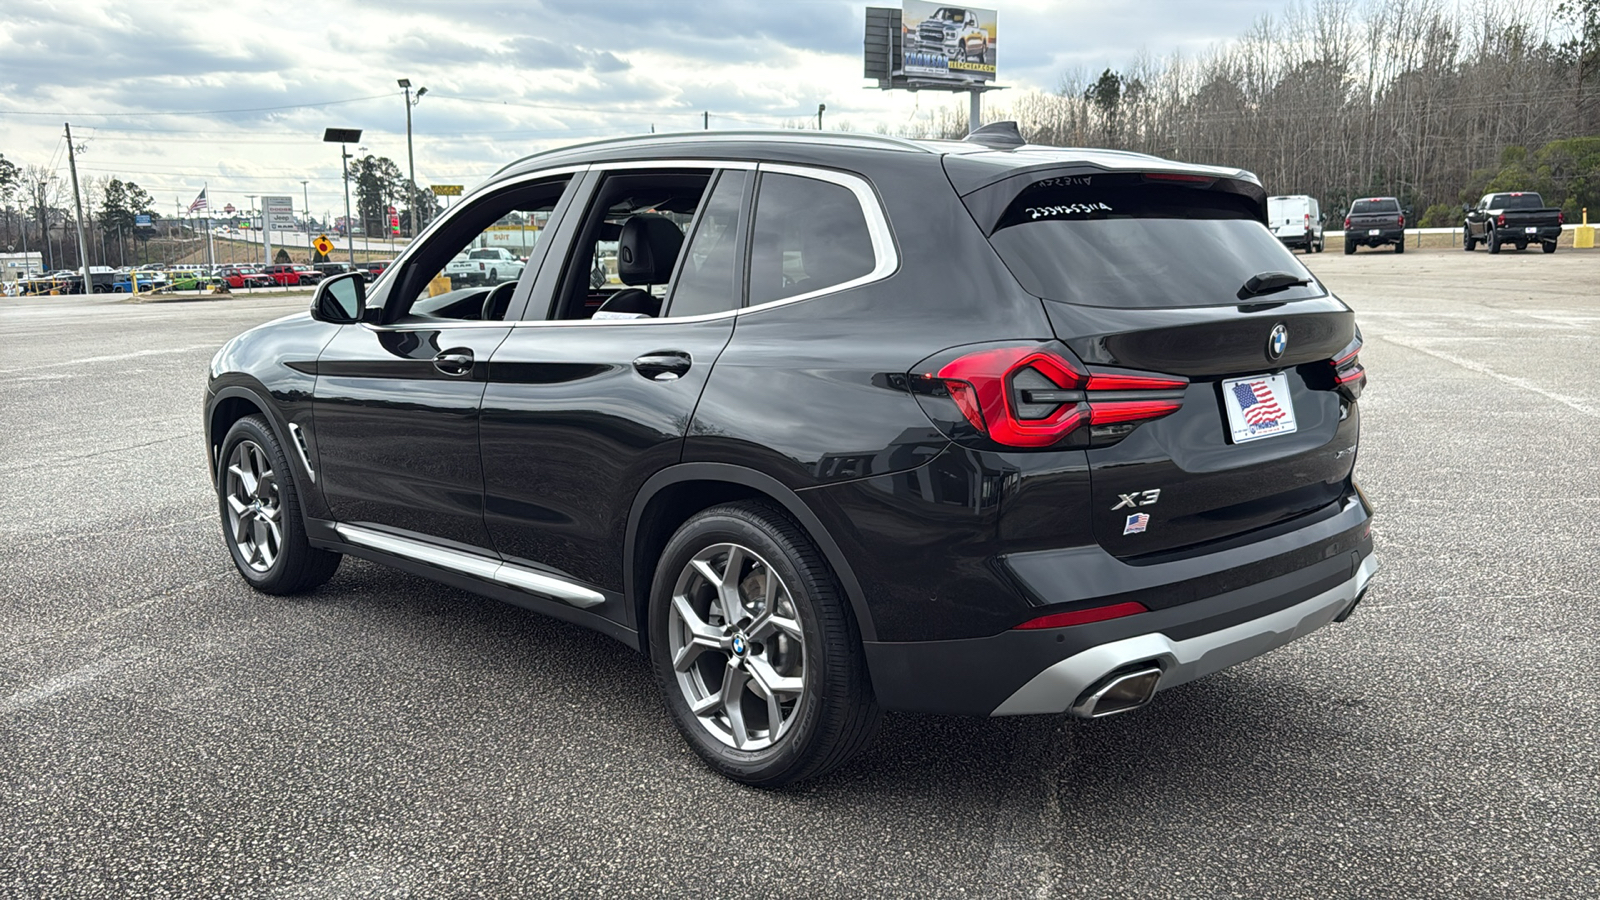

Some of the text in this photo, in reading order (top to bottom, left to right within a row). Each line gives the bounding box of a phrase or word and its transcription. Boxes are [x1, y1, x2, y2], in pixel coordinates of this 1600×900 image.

[904, 52, 949, 69] THOMSON
[949, 61, 995, 72] JEEPCHEAP.COM
[1025, 202, 1113, 219] 233425311A
[1110, 488, 1161, 511] X3
